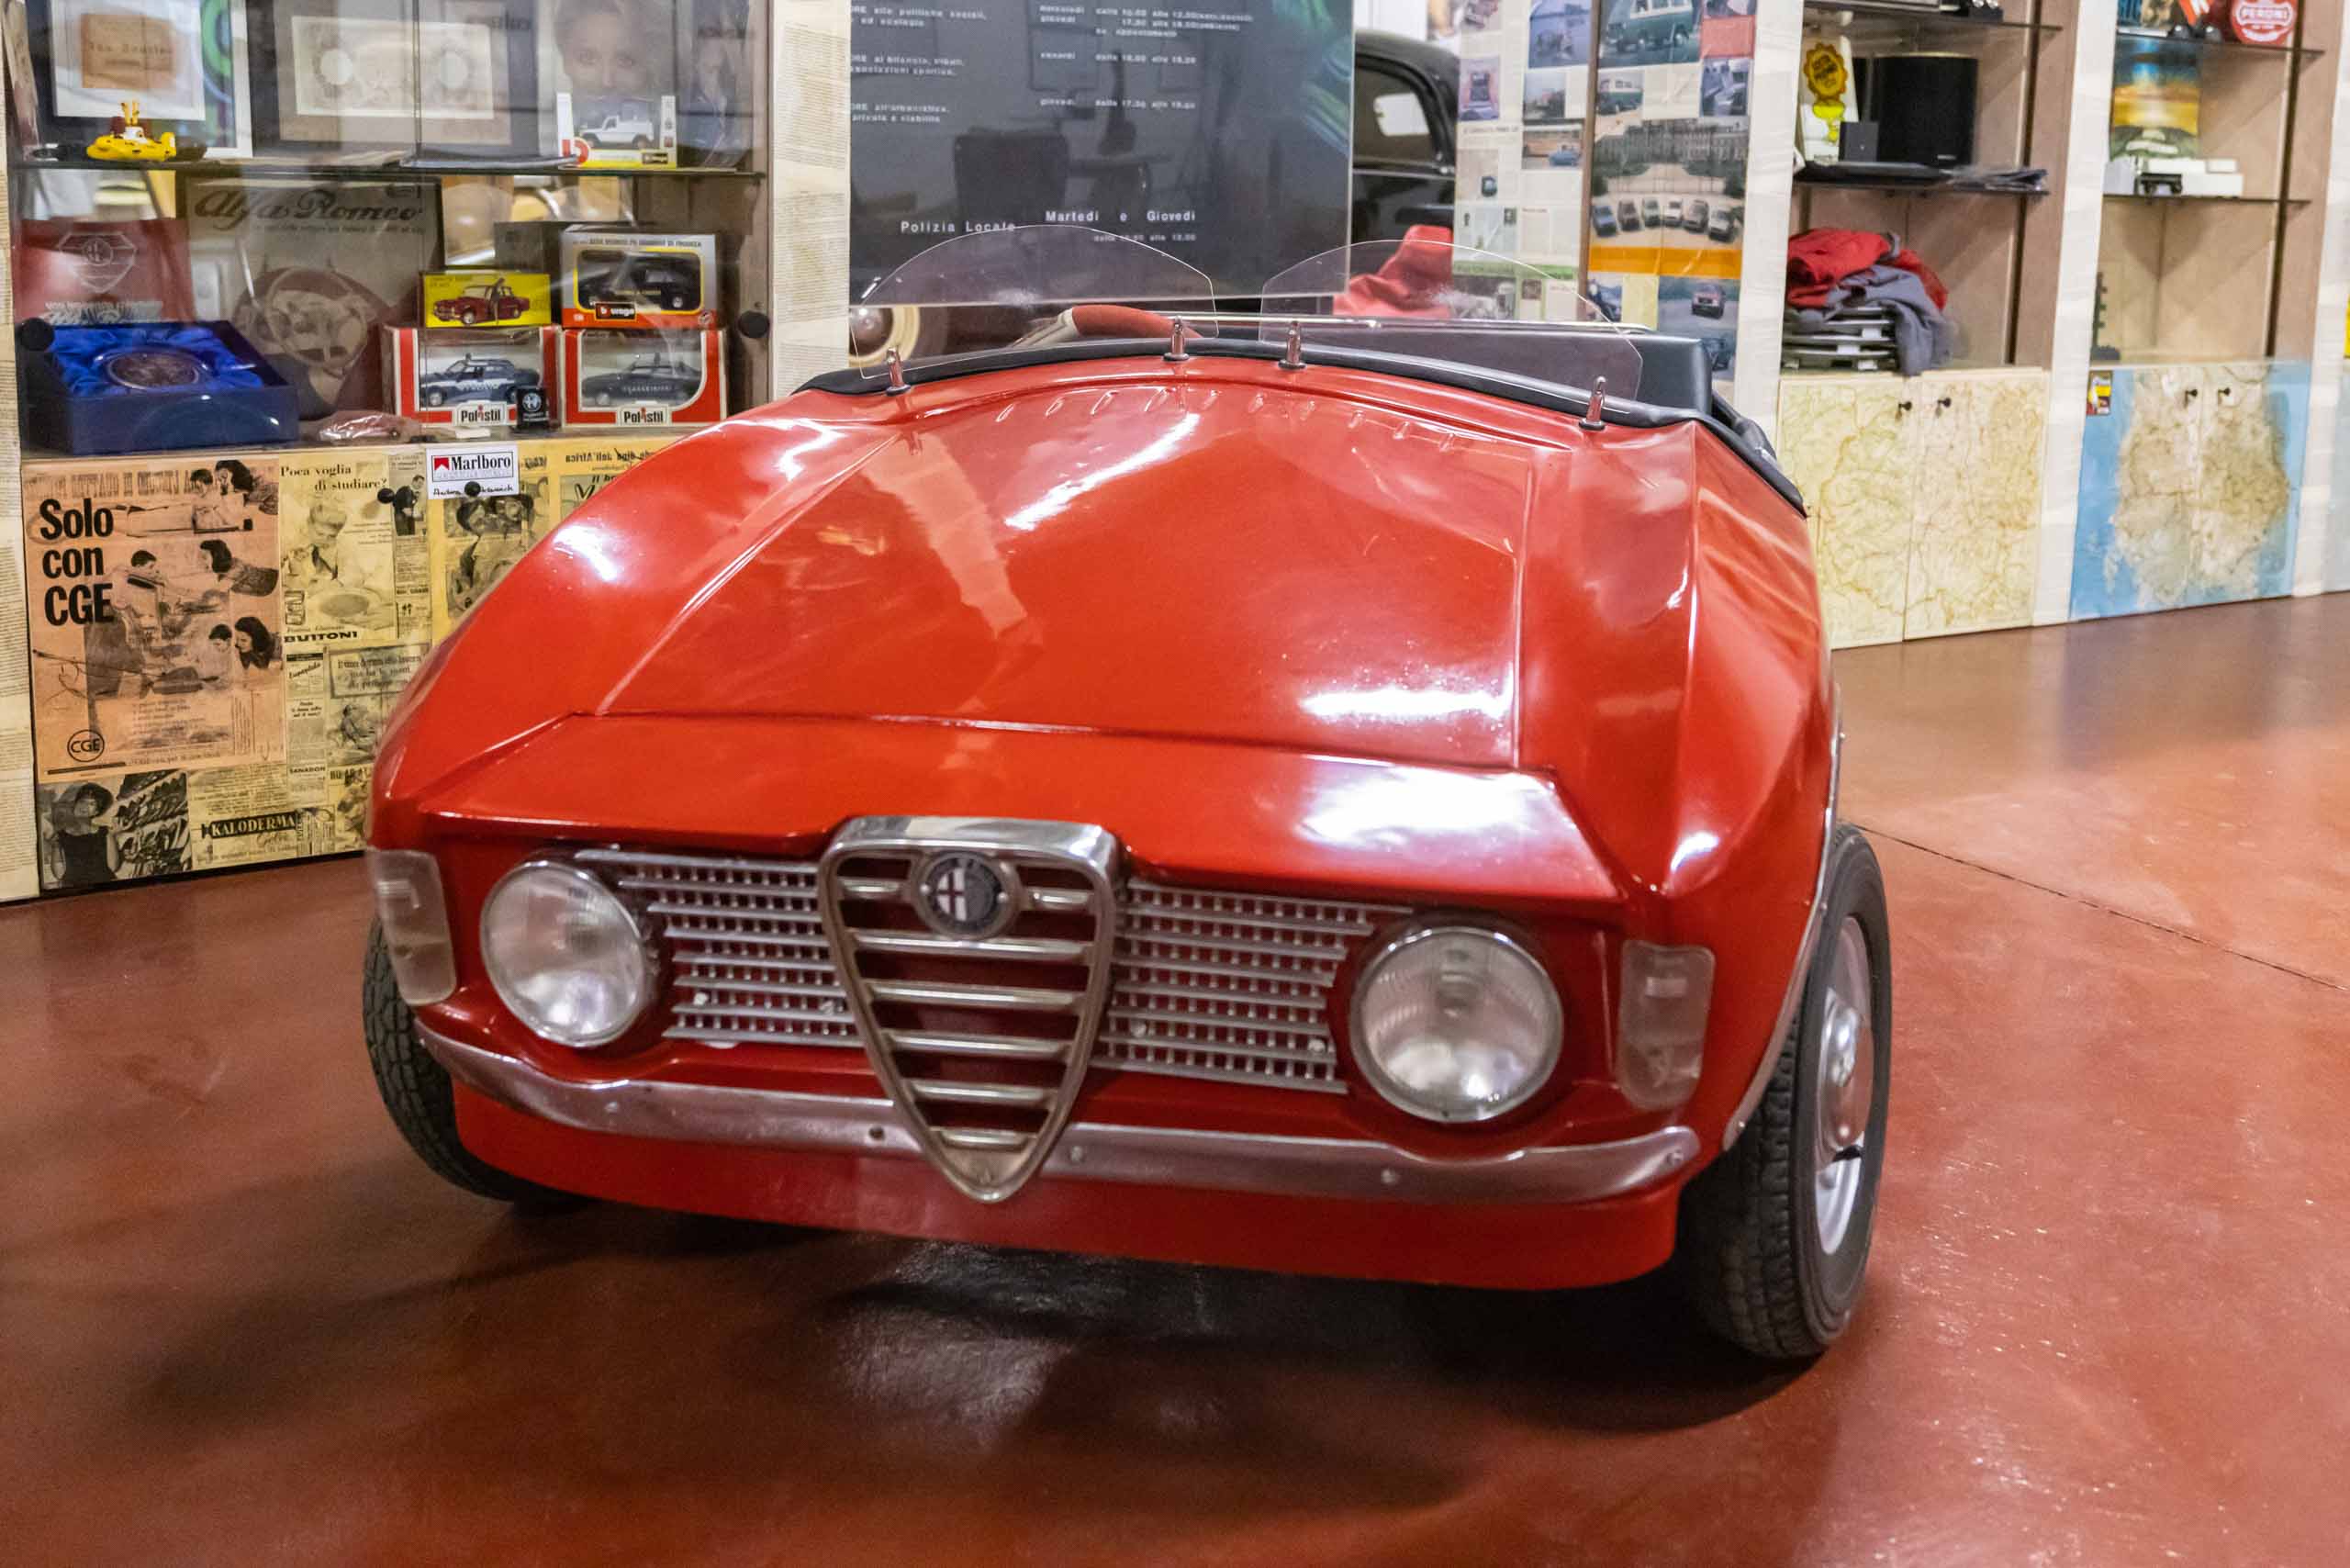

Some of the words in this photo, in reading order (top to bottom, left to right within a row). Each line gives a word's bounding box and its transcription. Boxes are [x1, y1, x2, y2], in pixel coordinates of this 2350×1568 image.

[194, 189, 288, 230] Alfa
[294, 188, 416, 220] Romeo
[1120, 214, 1127, 222] e
[901, 221, 956, 232] Polizia
[966, 221, 1015, 232] Locale
[461, 405, 501, 422] Polistil
[623, 407, 664, 423] Polistil
[452, 455, 511, 471] Marlboro
[281, 465, 310, 477] Poca
[316, 465, 352, 478] voglia
[315, 479, 327, 492] di
[332, 477, 387, 490] studiare?
[39, 498, 114, 541] Solo
[42, 546, 105, 579] con
[44, 583, 115, 626] CGE
[284, 631, 358, 643] BUITONI
[70, 738, 101, 754] CGE
[211, 813, 296, 837] KALODERMA
